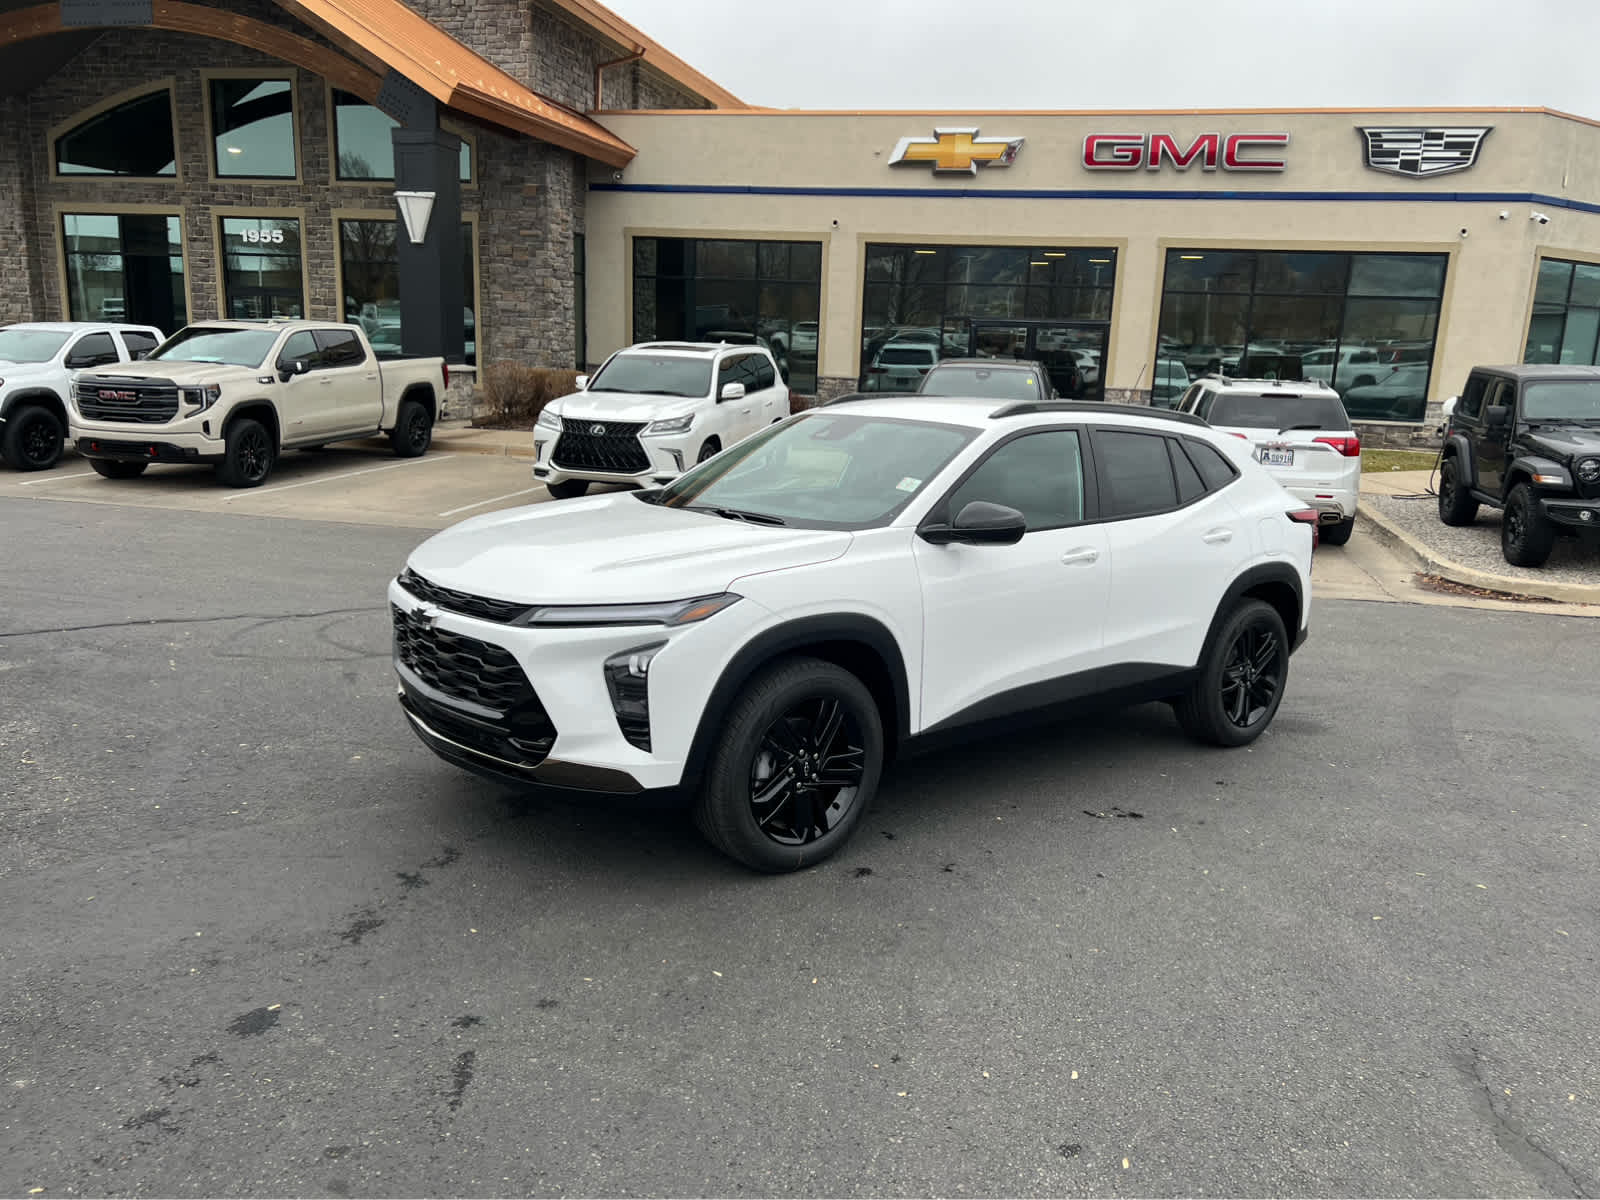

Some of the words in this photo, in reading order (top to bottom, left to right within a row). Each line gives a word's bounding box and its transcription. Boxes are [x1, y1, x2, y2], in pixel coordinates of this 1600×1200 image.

[1082, 132, 1289, 172] GMC
[240, 229, 284, 243] 1955
[98, 390, 136, 401] GMC
[1266, 441, 1293, 449] GMC
